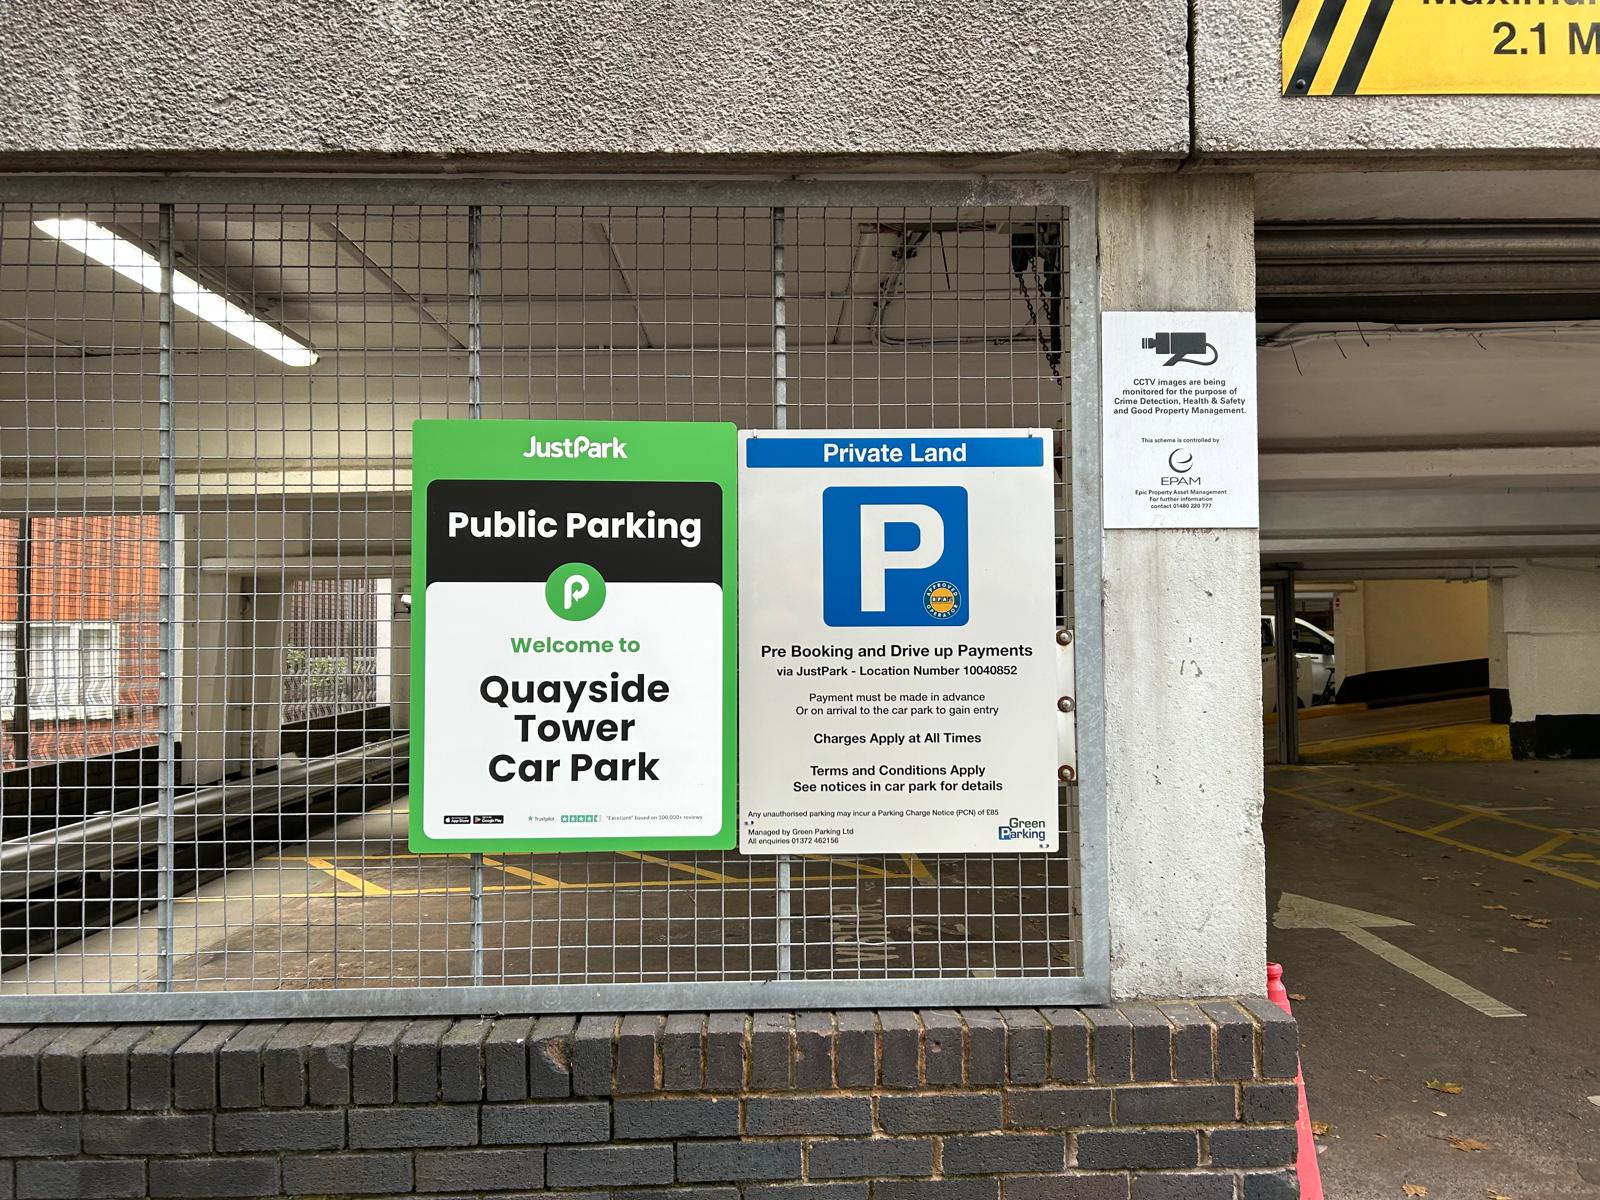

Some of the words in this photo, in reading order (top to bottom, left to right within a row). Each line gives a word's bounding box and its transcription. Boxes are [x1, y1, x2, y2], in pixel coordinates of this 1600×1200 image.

[1492, 21, 1546, 55] 2.1
[1157, 378, 1187, 387] images
[1203, 378, 1226, 387] being
[1122, 387, 1164, 395] monitored
[1165, 387, 1178, 395] for
[1140, 397, 1181, 405] Detection,
[1211, 397, 1218, 405] &
[1219, 396, 1246, 406] Safety
[1113, 407, 1129, 415] and
[1130, 406, 1153, 415] Good
[1155, 406, 1190, 416] Property
[1191, 406, 1247, 416] Management.
[522, 435, 628, 459] JustPark
[823, 443, 903, 463] Private
[910, 442, 967, 463] Land
[1160, 476, 1201, 486] EPAM
[448, 508, 558, 538] Public
[566, 509, 702, 548] Parking
[859, 503, 945, 612] P
[926, 582, 958, 597] APPROVED
[926, 604, 959, 618] OPERATOR
[510, 636, 614, 653] Welcome
[618, 637, 641, 653] to
[761, 645, 787, 658] Pre
[791, 644, 853, 660] Booking
[858, 644, 886, 657] and
[891, 644, 930, 657] Drive
[934, 647, 953, 660] up
[958, 644, 1033, 660] Payments
[776, 666, 793, 676] via
[796, 666, 848, 677] JustPark
[859, 665, 910, 676] Location
[913, 665, 960, 676] Number
[963, 665, 1018, 675] 10040852
[479, 671, 670, 713] Quayside
[809, 693, 854, 704] Payment
[856, 693, 881, 702] must
[884, 692, 897, 702] be
[899, 692, 928, 702] made
[930, 692, 940, 702] in
[942, 692, 986, 702] advance
[795, 705, 809, 716] Or
[826, 705, 857, 715] arrival
[859, 706, 871, 715] to
[872, 705, 889, 715] the
[910, 705, 934, 717] park
[935, 706, 947, 715] to
[948, 705, 971, 717] gain
[973, 705, 999, 717] entry
[514, 714, 636, 743] Tower
[813, 733, 867, 746] Charges
[869, 732, 905, 746] Apply
[908, 733, 921, 744] at
[924, 732, 940, 743] All
[943, 732, 982, 743] Times
[488, 753, 561, 783] Car
[570, 751, 660, 782] Park
[810, 765, 849, 776] Terms
[852, 765, 875, 776] and
[879, 764, 947, 776] Conditions
[950, 764, 986, 778] Apply
[793, 781, 817, 792] See
[820, 781, 867, 792] notices
[870, 780, 881, 792] in
[884, 783, 906, 792] car
[908, 780, 937, 794] park
[940, 780, 958, 791] for
[961, 780, 1003, 791] details
[747, 810, 762, 819] Any
[809, 810, 835, 818] parking
[877, 809, 904, 818] Parking
[905, 809, 931, 818] Charge
[955, 809, 976, 817] (PCN)
[1008, 817, 1046, 830] Green
[748, 828, 781, 837] Managed
[781, 829, 791, 837] by
[814, 828, 841, 836] Parking
[999, 827, 1046, 841] Parking
[758, 837, 790, 846] enquiries
